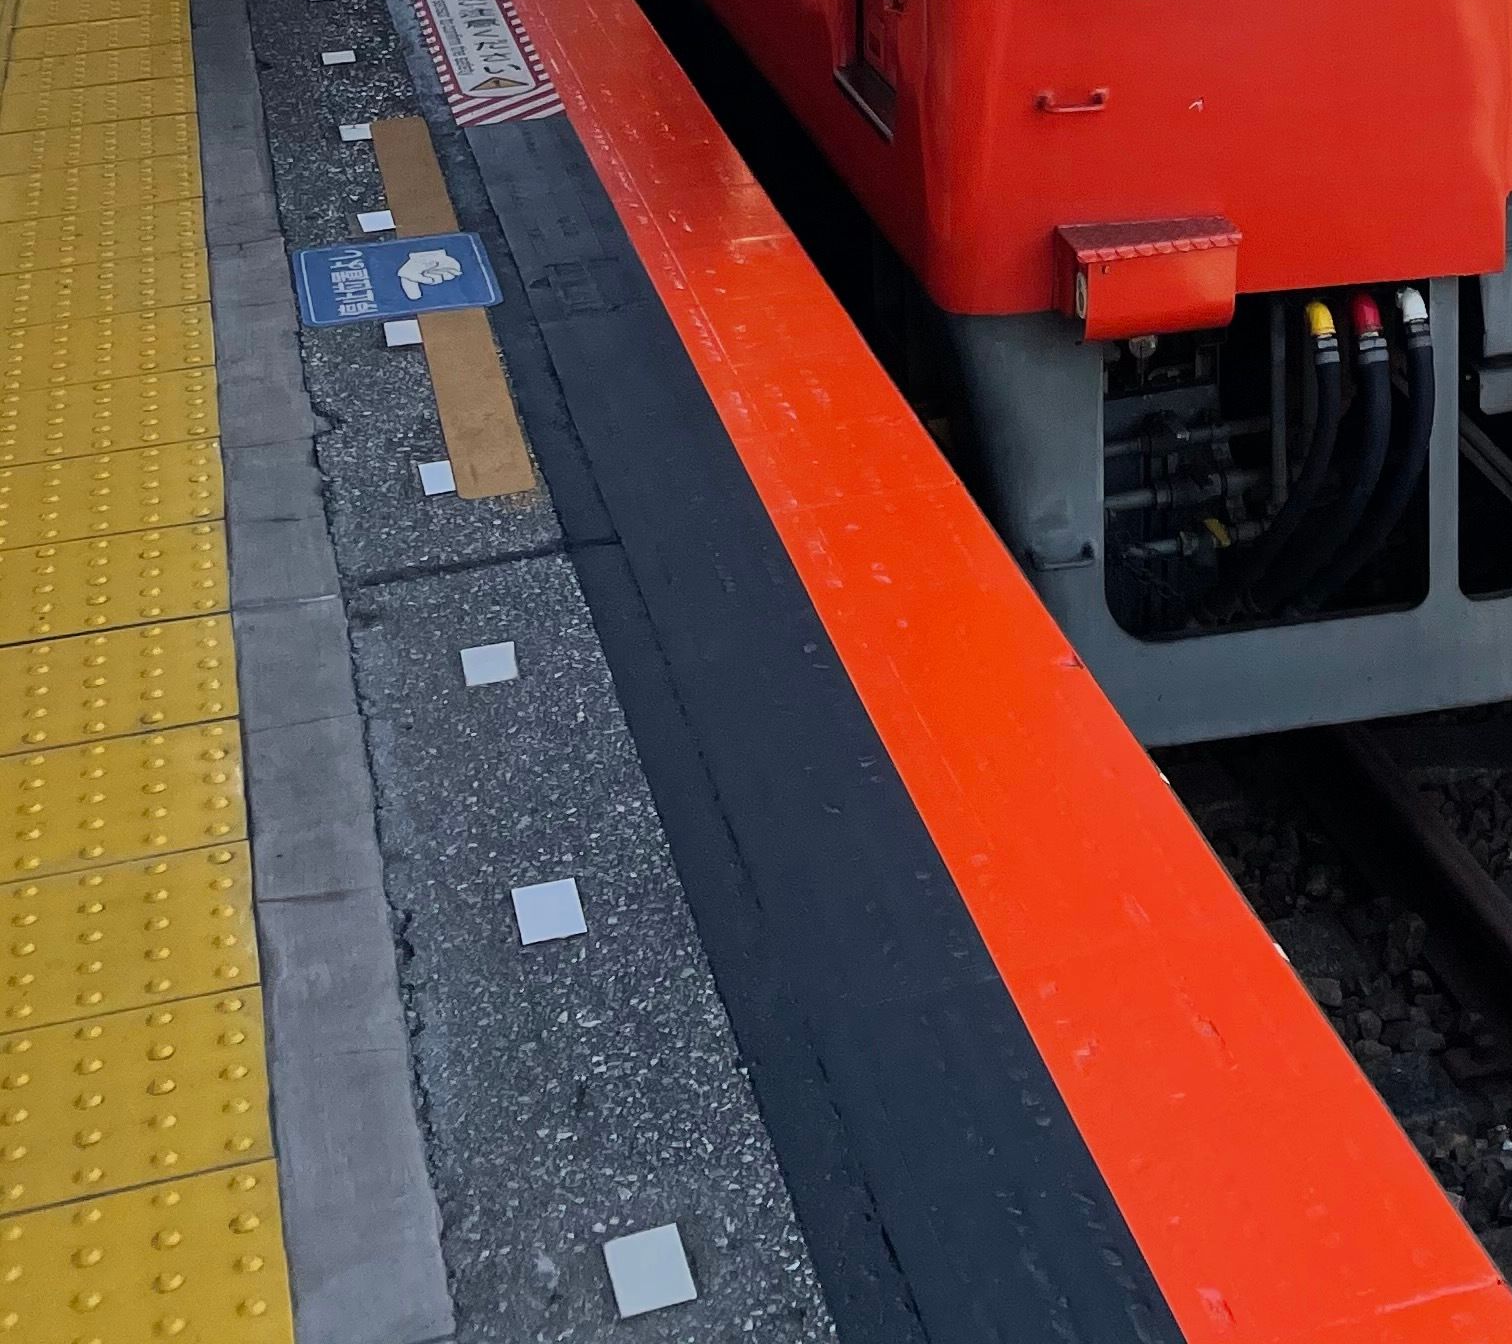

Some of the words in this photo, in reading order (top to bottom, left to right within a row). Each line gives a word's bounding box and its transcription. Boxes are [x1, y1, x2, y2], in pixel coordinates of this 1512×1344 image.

[328, 249, 379, 317] 停止位置よし
